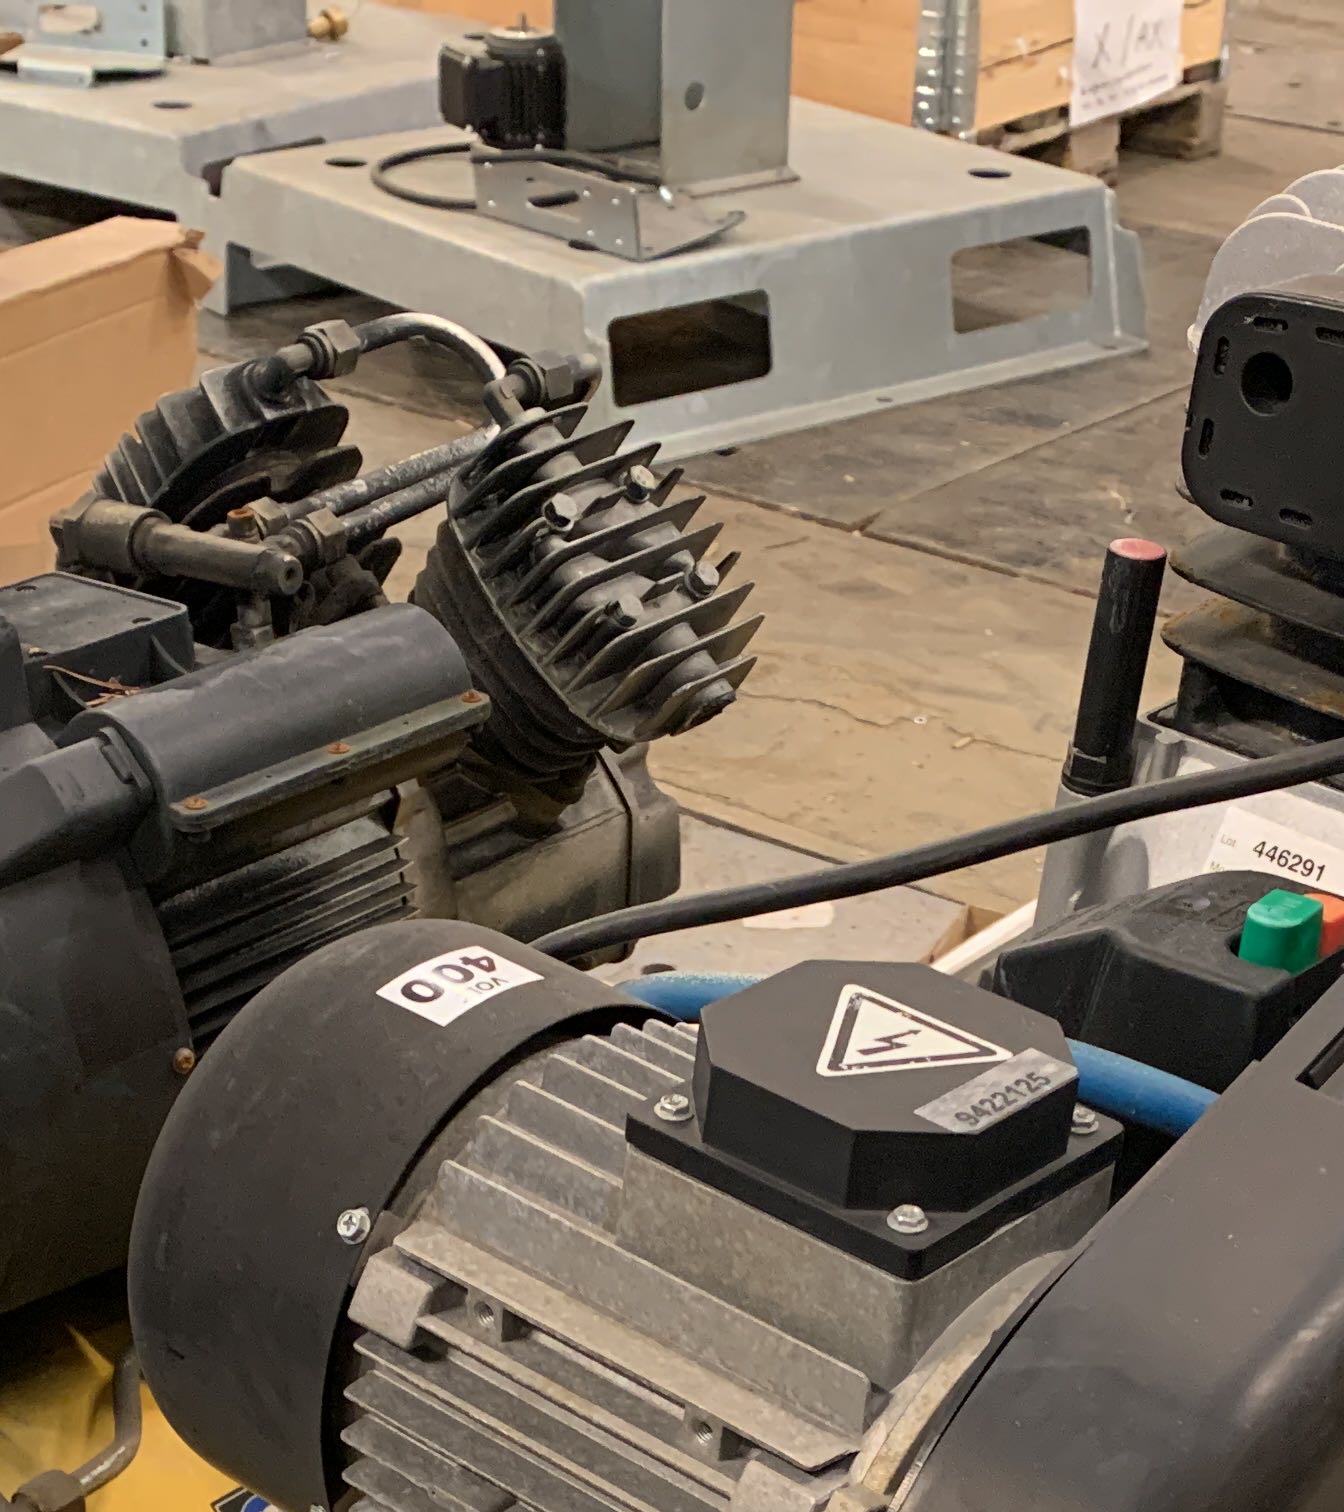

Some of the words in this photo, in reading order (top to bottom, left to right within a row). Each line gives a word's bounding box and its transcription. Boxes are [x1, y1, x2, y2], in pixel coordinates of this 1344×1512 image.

[1253, 841, 1325, 882] 446291
[400, 955, 496, 1003] 400
[955, 1072, 1050, 1126] 9422125
